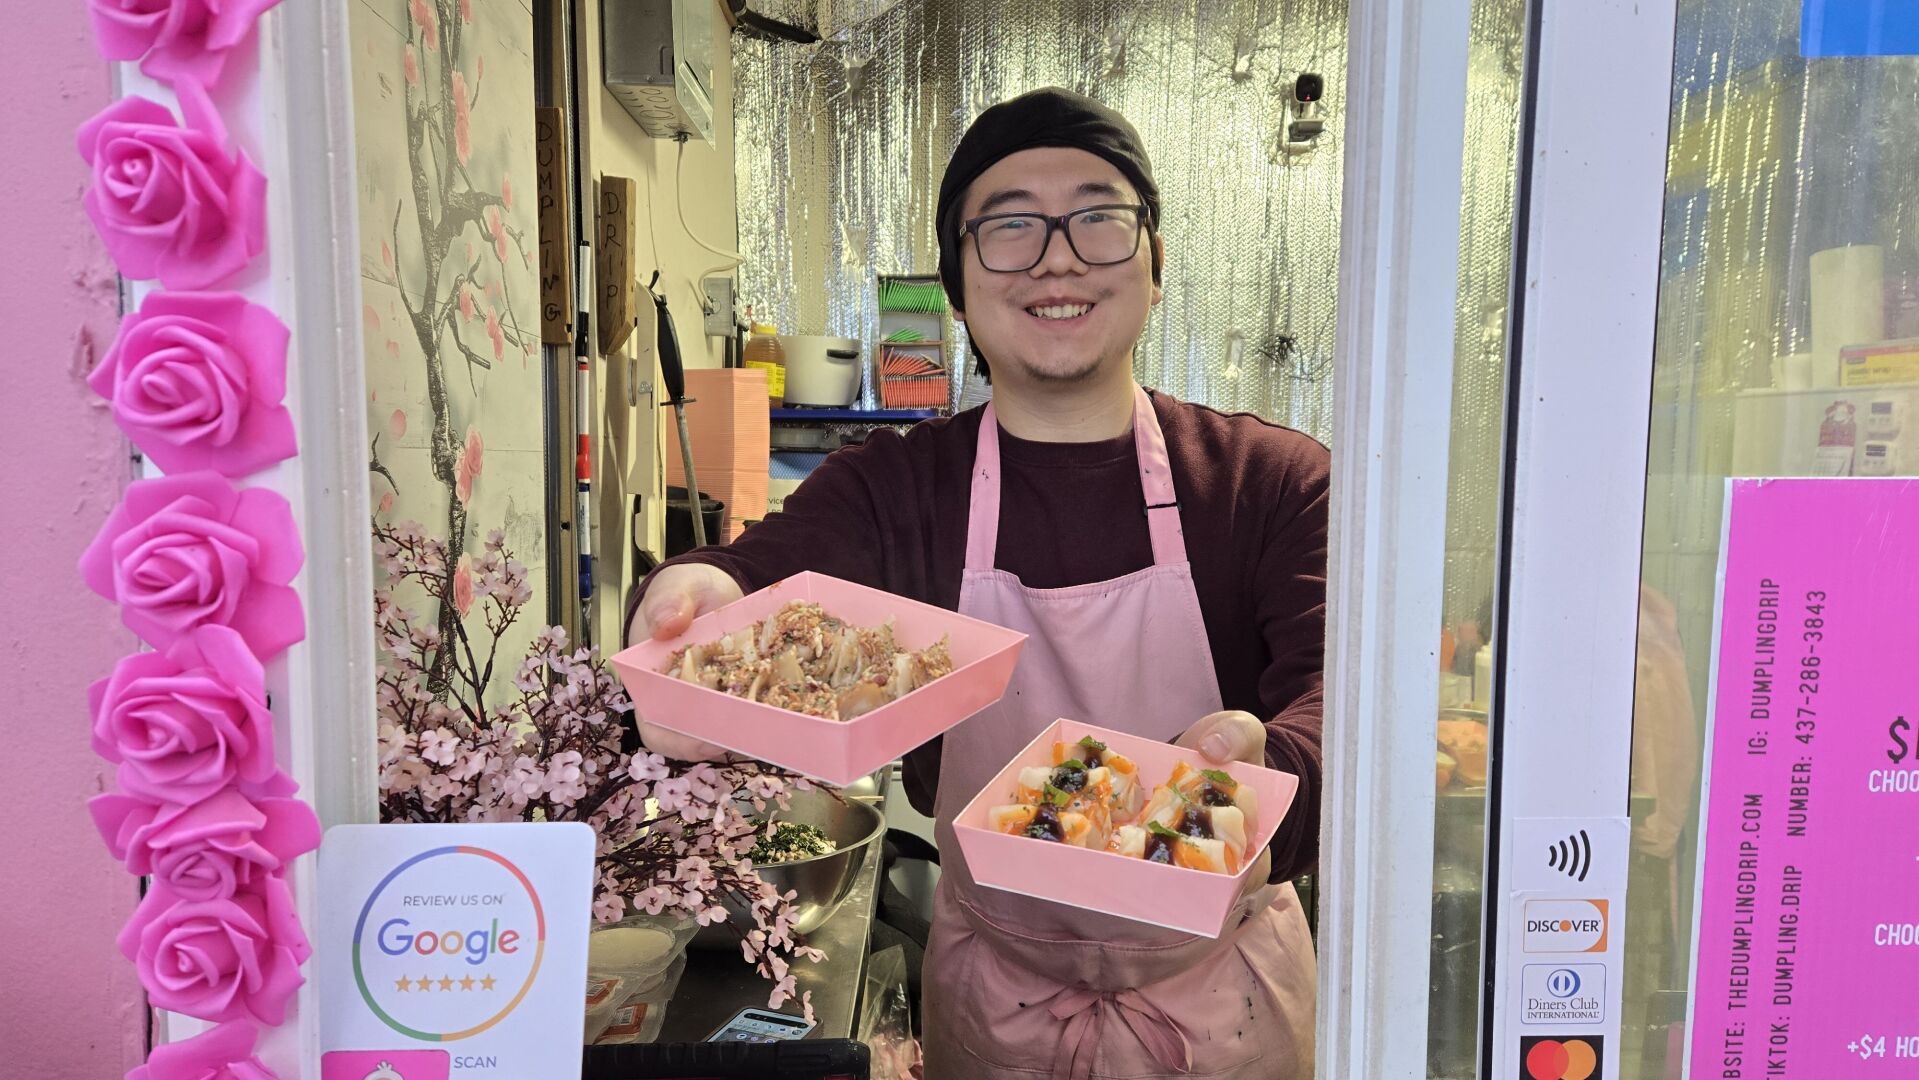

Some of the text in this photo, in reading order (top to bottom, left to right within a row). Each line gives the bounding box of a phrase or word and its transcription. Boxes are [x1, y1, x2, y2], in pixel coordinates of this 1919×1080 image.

[536, 121, 562, 322] DUMPLING
[604, 191, 622, 309] DRIP
[1750, 578, 1780, 720] DUMPLINGDRIP
[1747, 730, 1768, 755] IG:
[1766, 591, 1826, 1080] IKTOK: DUMPLING.DRIP NUMBER: 437-286-3843
[403, 895, 503, 907] REVIEW US ON
[1728, 794, 1763, 1011] THEDUMPLINGDRIP.COM
[1527, 919, 1600, 932] DISCOVER
[377, 918, 520, 966] Google
[1527, 1011, 1600, 1019] INTERNATIONAL
[1528, 997, 1599, 1010] Diners Club
[1847, 1034, 1886, 1060] +$4
[453, 1056, 497, 1069] SCAN
